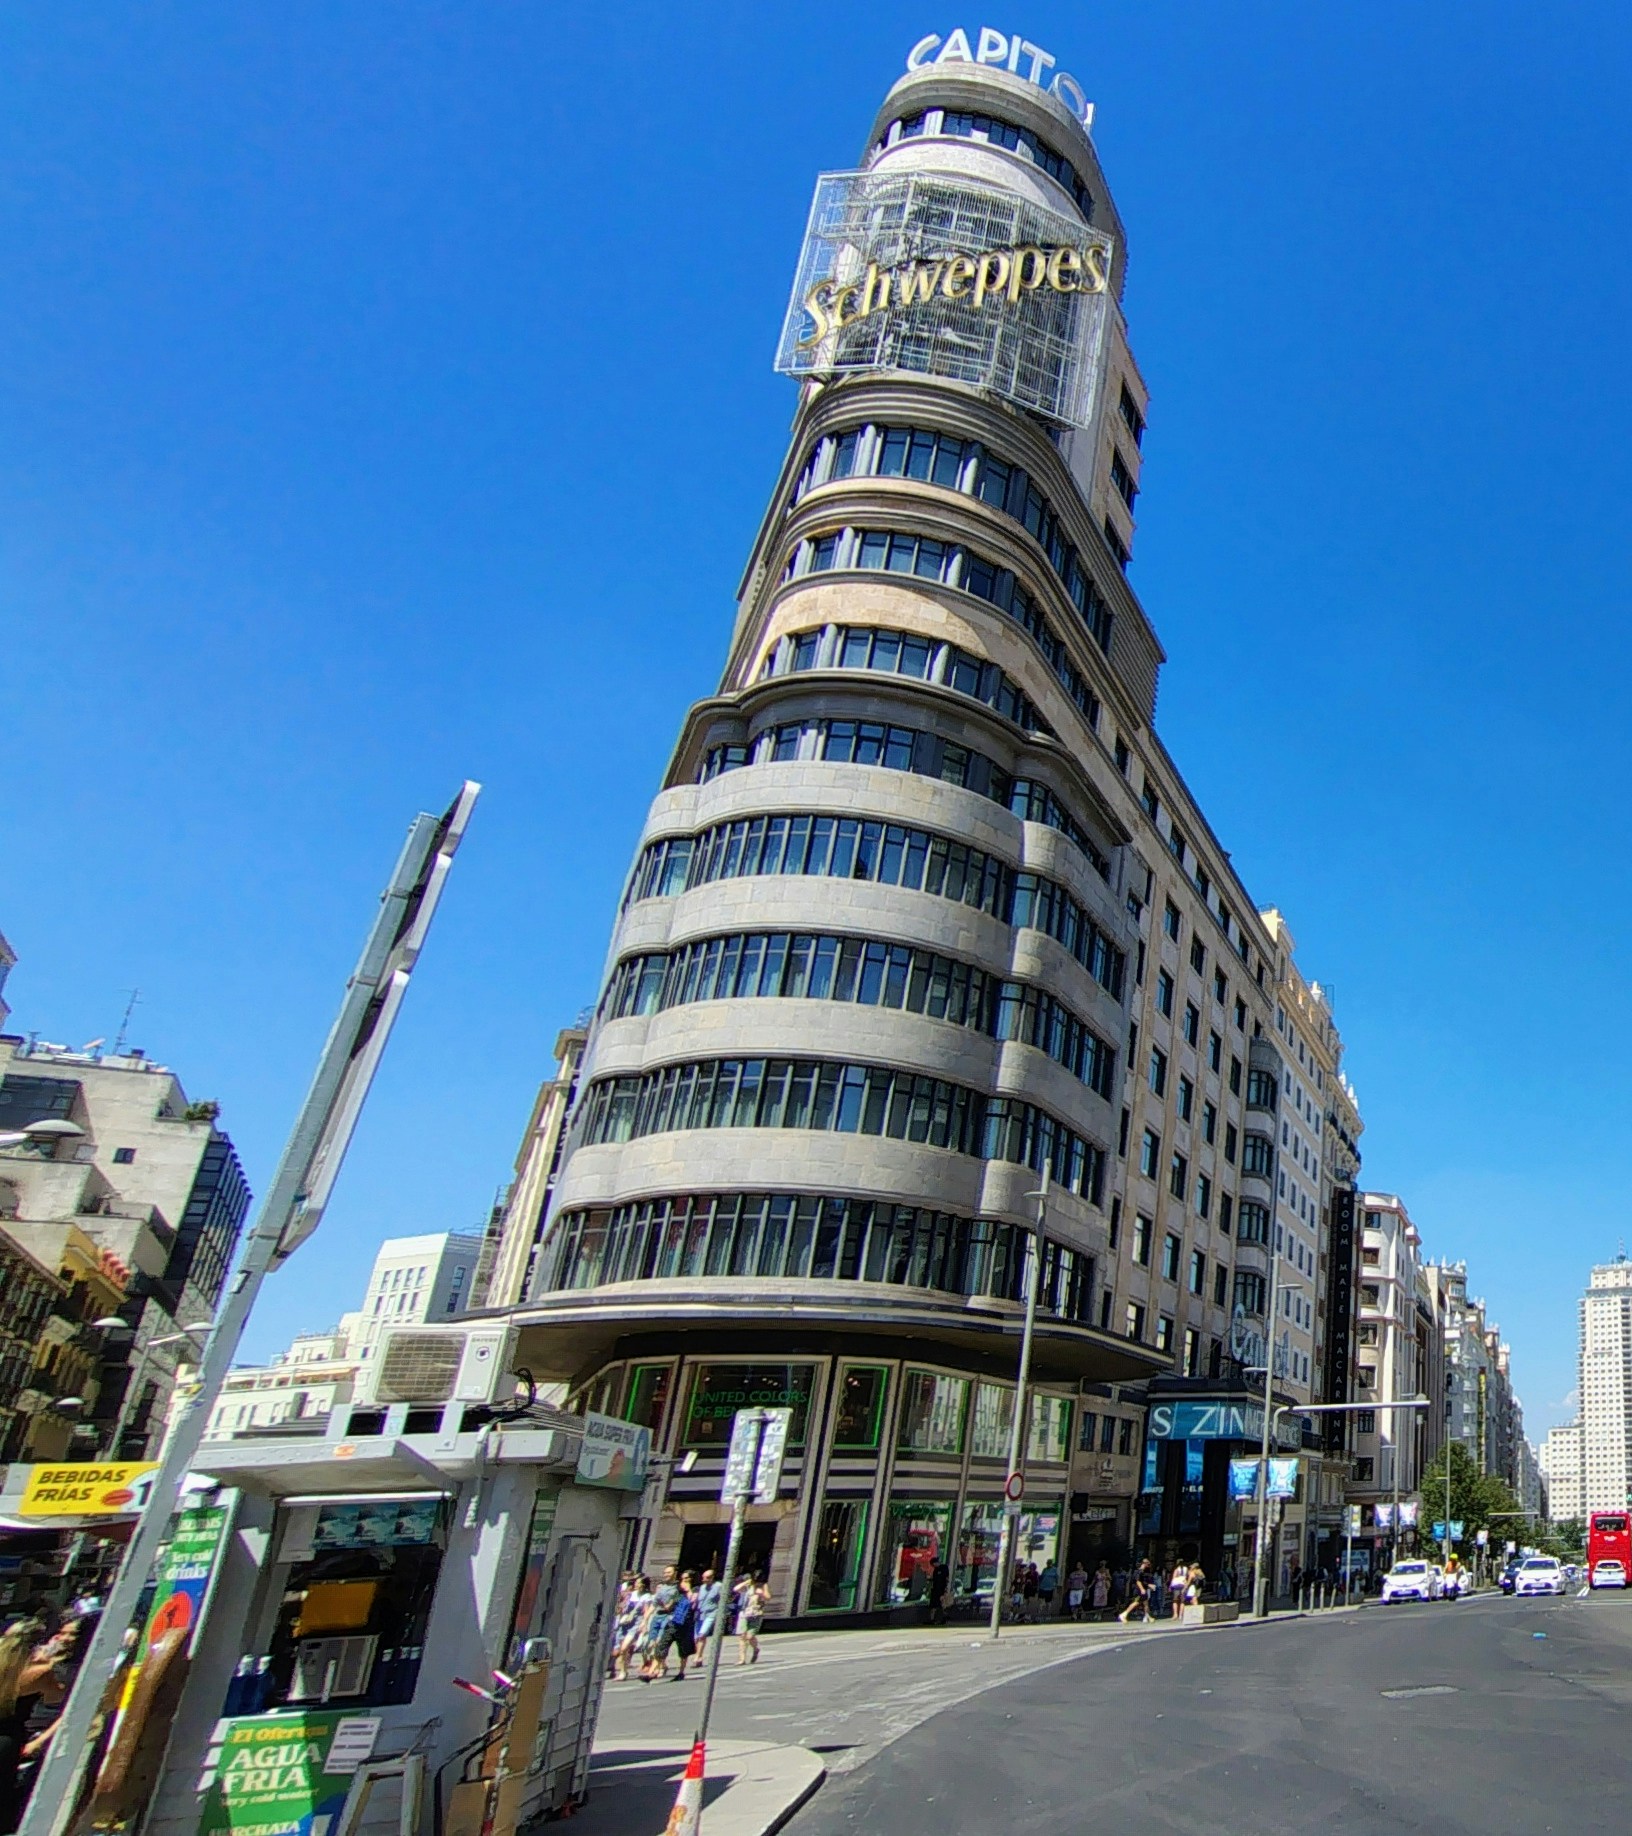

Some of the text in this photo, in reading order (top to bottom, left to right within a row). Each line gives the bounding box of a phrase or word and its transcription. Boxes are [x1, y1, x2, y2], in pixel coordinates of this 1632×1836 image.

[796, 241, 1109, 350] Schweppes
[1338, 1263, 1348, 1314] MATE
[749, 1390, 808, 1403] COLORS
[1333, 1331, 1346, 1443] MACARNA
[38, 1468, 128, 1485] BEBIDAS
[32, 1484, 94, 1502] FRÍAS
[227, 1742, 323, 1771] AGUA
[222, 1767, 310, 1794] FRIA
